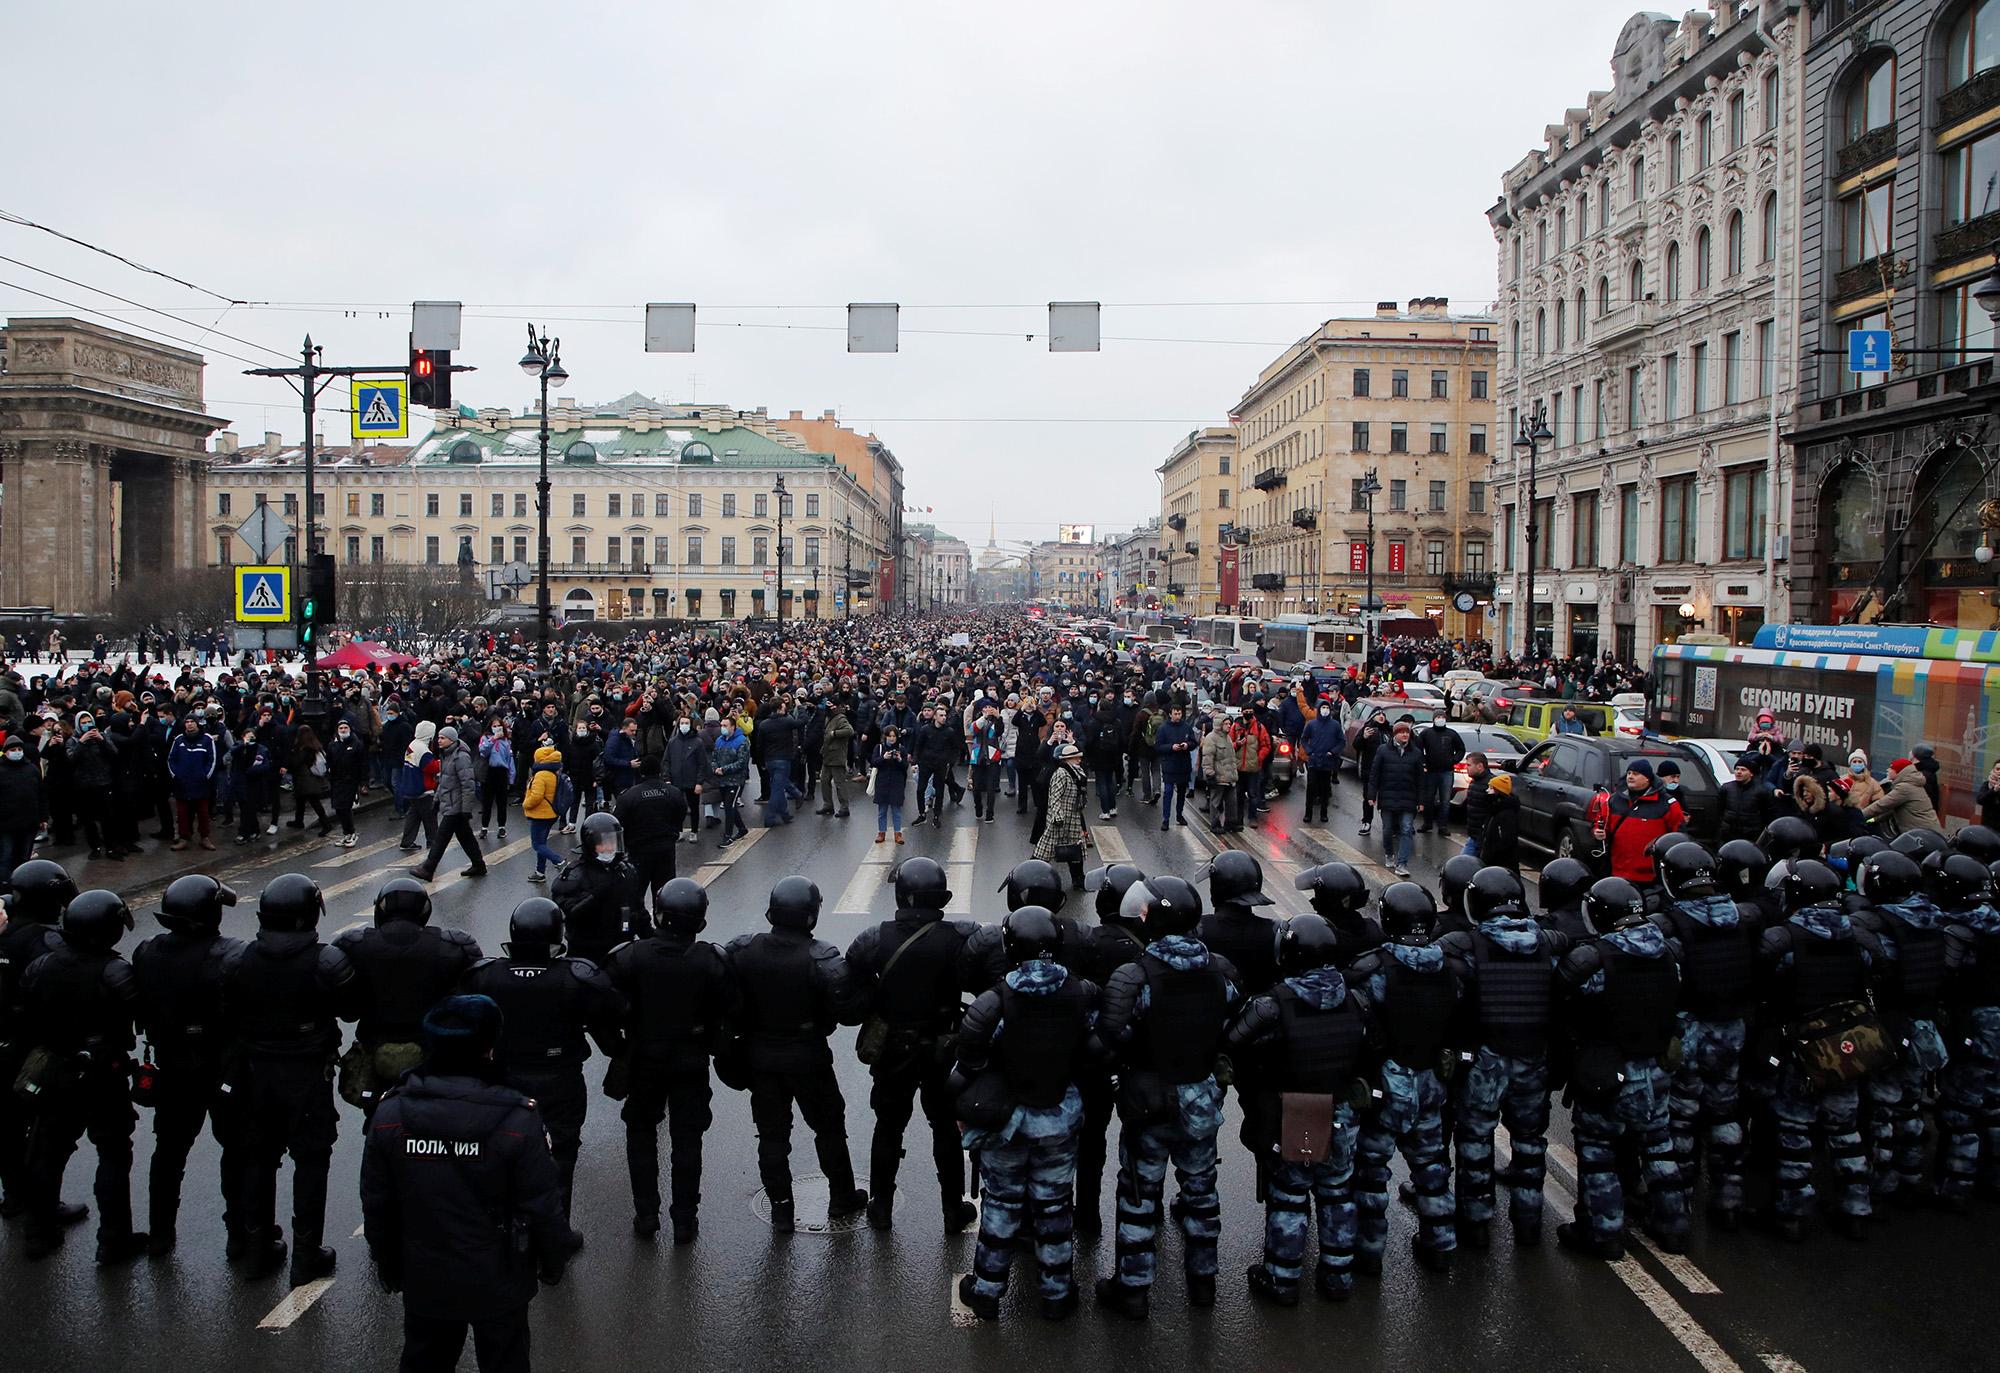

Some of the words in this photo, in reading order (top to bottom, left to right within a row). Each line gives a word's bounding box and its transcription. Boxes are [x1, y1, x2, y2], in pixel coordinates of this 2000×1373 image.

[1842, 640, 1864, 650] района
[1864, 641, 1920, 654] Санкт-Петербурга
[1740, 687, 1801, 712] СЕГОДНЯ
[1804, 694, 1855, 720] БУДЕТ
[1688, 712, 1704, 724] 3510
[1803, 725, 1839, 747] ДЕНЬ
[1843, 730, 1853, 753] :)
